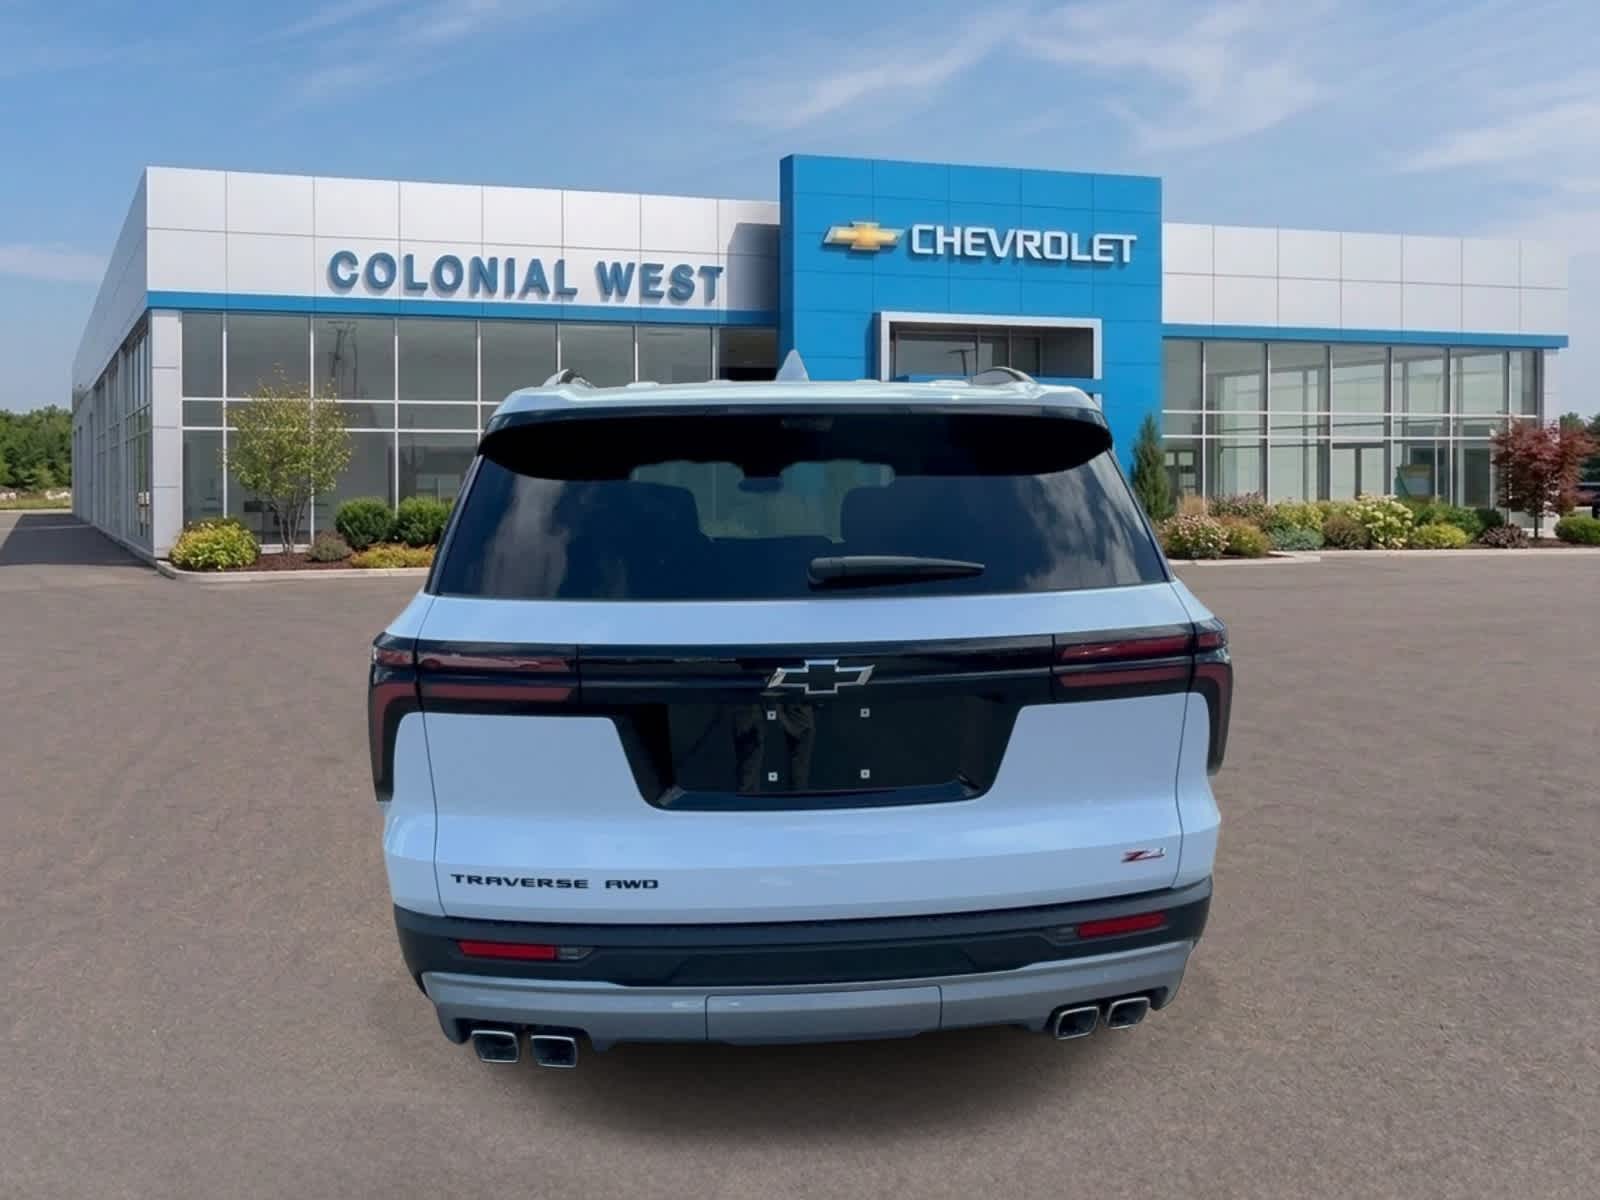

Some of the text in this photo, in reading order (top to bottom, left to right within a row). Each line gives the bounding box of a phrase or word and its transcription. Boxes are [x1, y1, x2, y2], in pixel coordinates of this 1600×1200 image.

[911, 224, 1137, 263] CHEVROLET
[328, 250, 724, 304] COLONIAL WEST
[451, 873, 659, 889] TRAVERSE AWD
